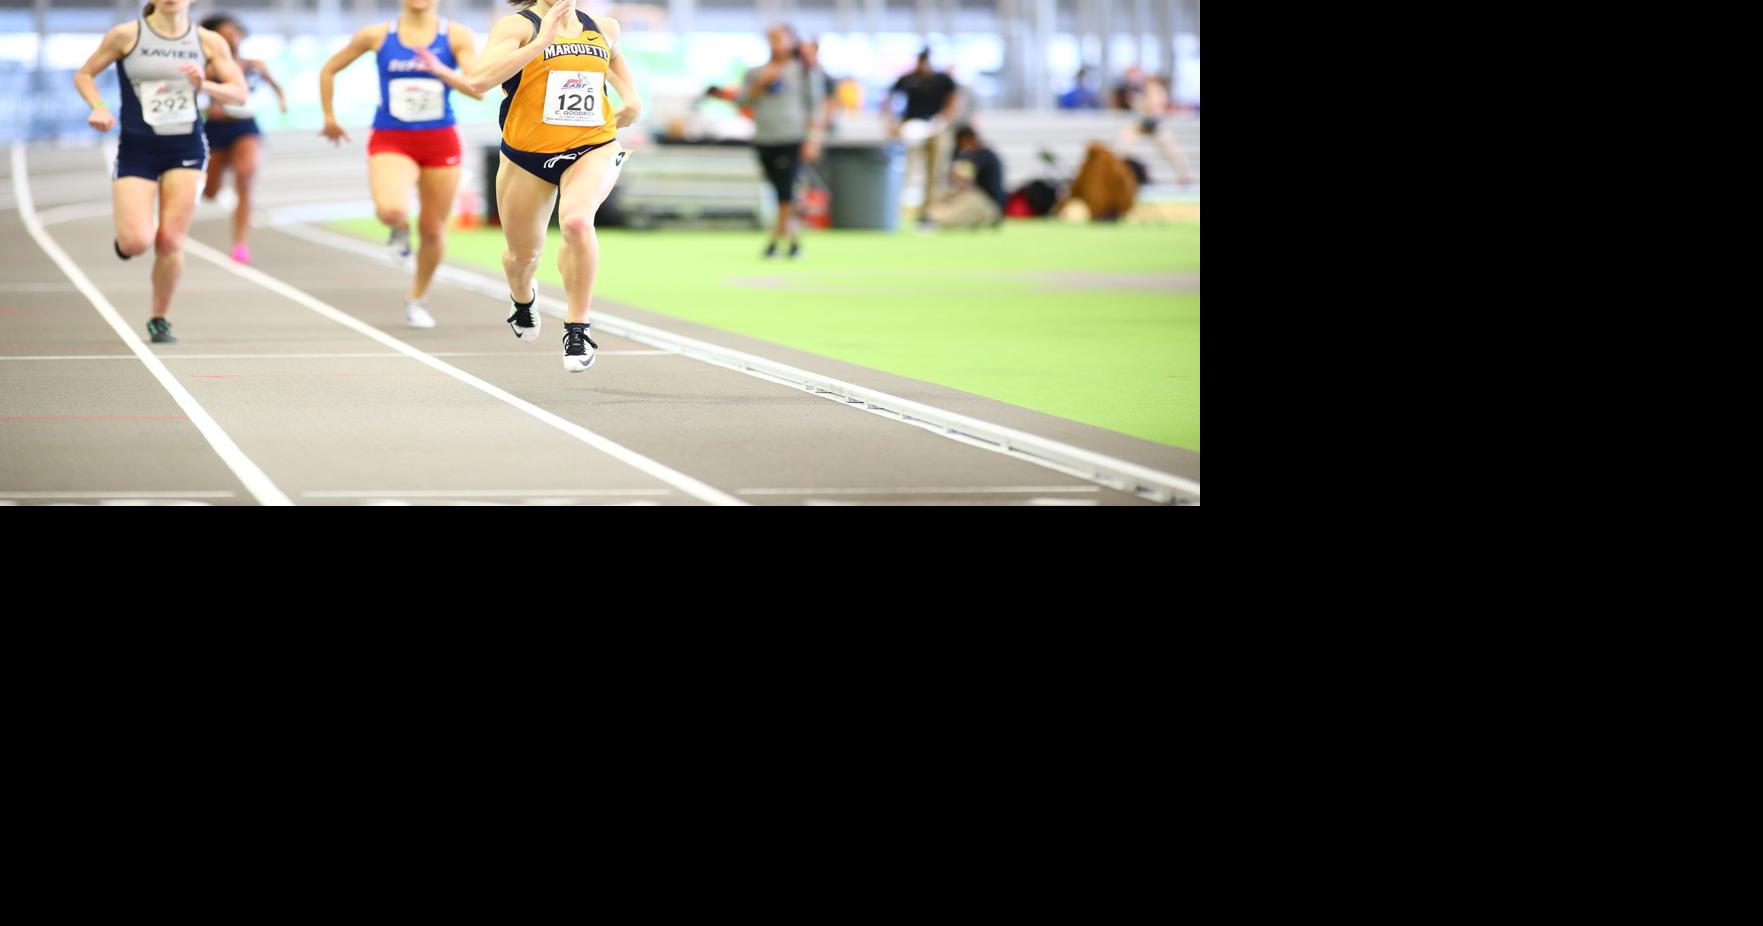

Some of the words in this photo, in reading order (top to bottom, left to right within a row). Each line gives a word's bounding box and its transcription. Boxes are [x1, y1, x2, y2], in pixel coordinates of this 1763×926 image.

[140, 47, 198, 59] XAVIER
[150, 96, 187, 113] 292
[558, 94, 595, 111] 120
